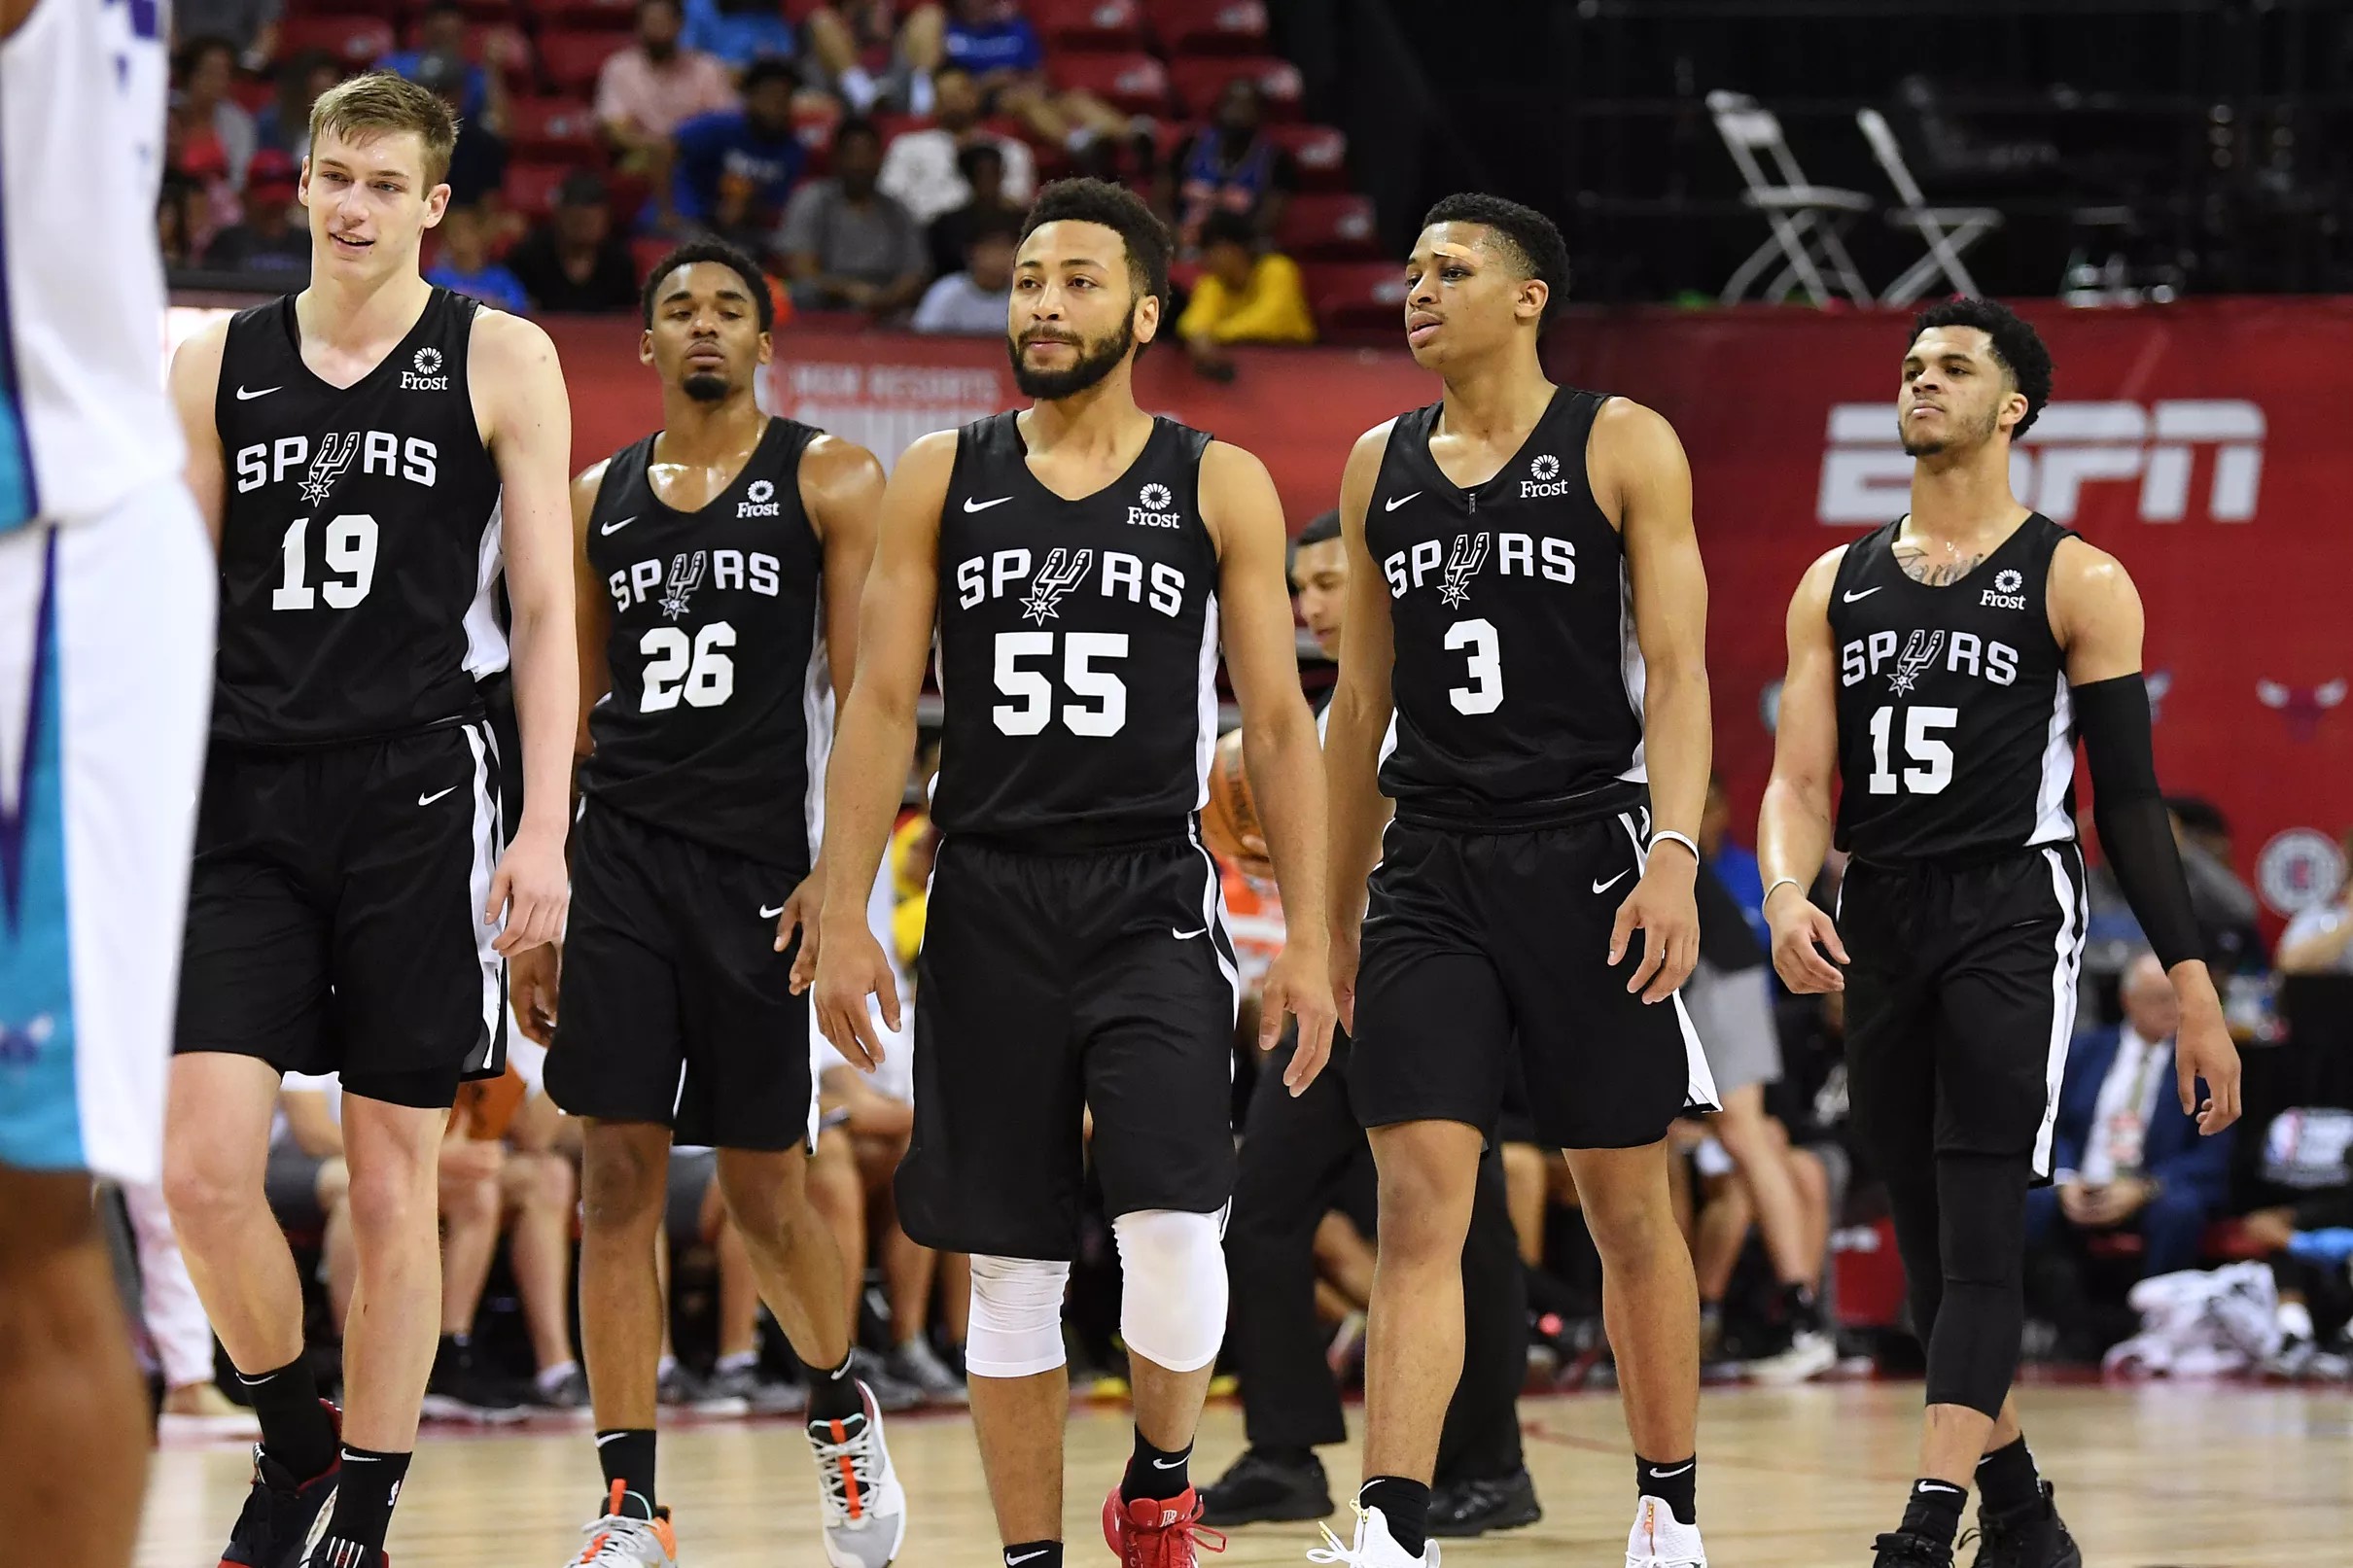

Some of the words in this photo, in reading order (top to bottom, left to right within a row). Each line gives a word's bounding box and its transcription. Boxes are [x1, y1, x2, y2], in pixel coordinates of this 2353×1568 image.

[400, 371, 449, 391] Frost
[236, 430, 438, 507] SPURS
[1520, 478, 1568, 500] Frost
[1816, 399, 2266, 526] EPN
[737, 500, 780, 519] Frost
[1127, 505, 1180, 530] Frost
[272, 514, 379, 610] 19
[609, 549, 781, 621] SPURS
[957, 547, 1185, 627] SPURS
[1384, 531, 1576, 610] SPURS
[1979, 589, 2026, 610] Frost
[639, 621, 737, 714] 26
[993, 631, 1129, 738] 55
[1444, 617, 1504, 715] 3
[1842, 629, 2019, 698] SPURS
[1869, 706, 1959, 795] 15
